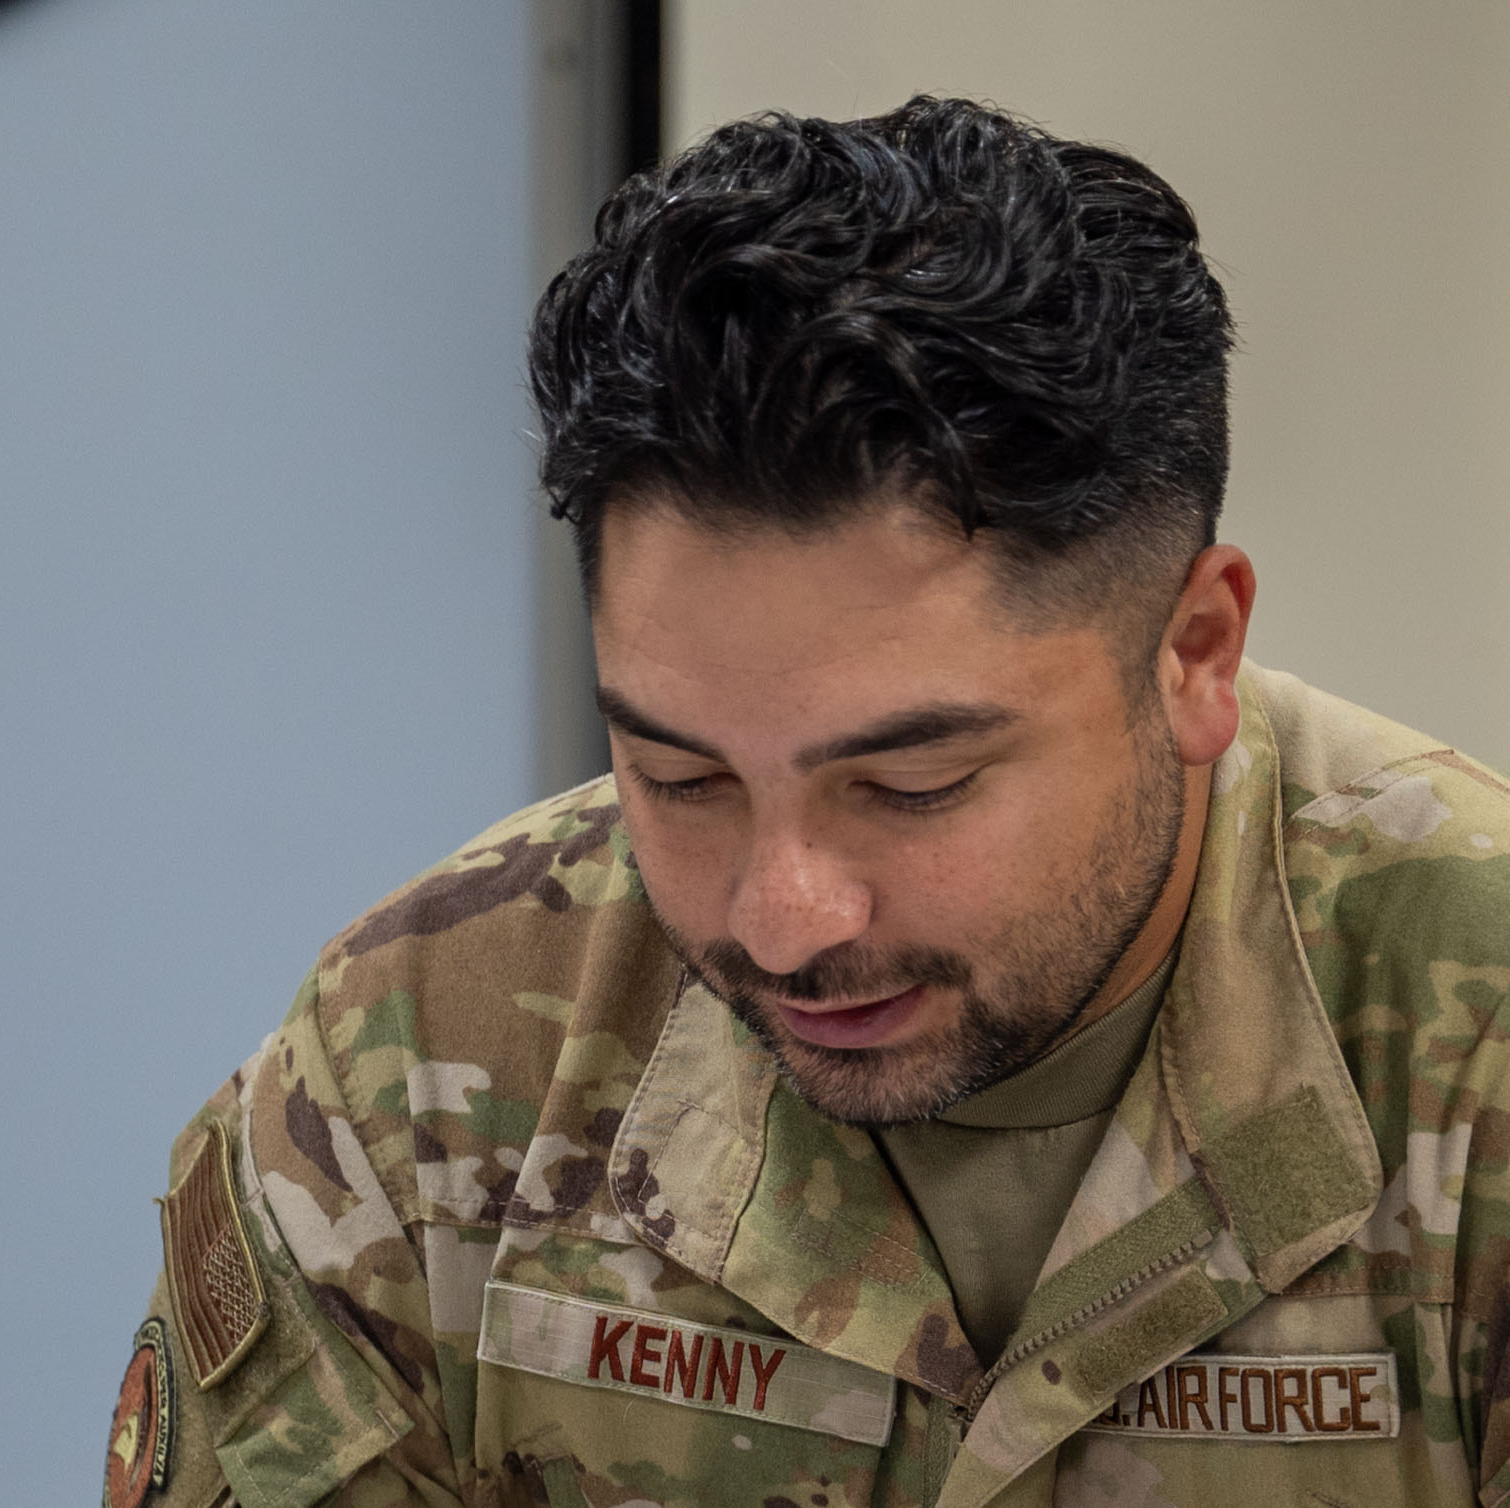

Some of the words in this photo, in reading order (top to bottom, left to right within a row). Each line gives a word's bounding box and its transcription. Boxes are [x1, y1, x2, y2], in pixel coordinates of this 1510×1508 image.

[588, 1316, 786, 1411] KENNY
[1136, 1365, 1214, 1430] AIR
[1218, 1366, 1380, 1433] FORCE
